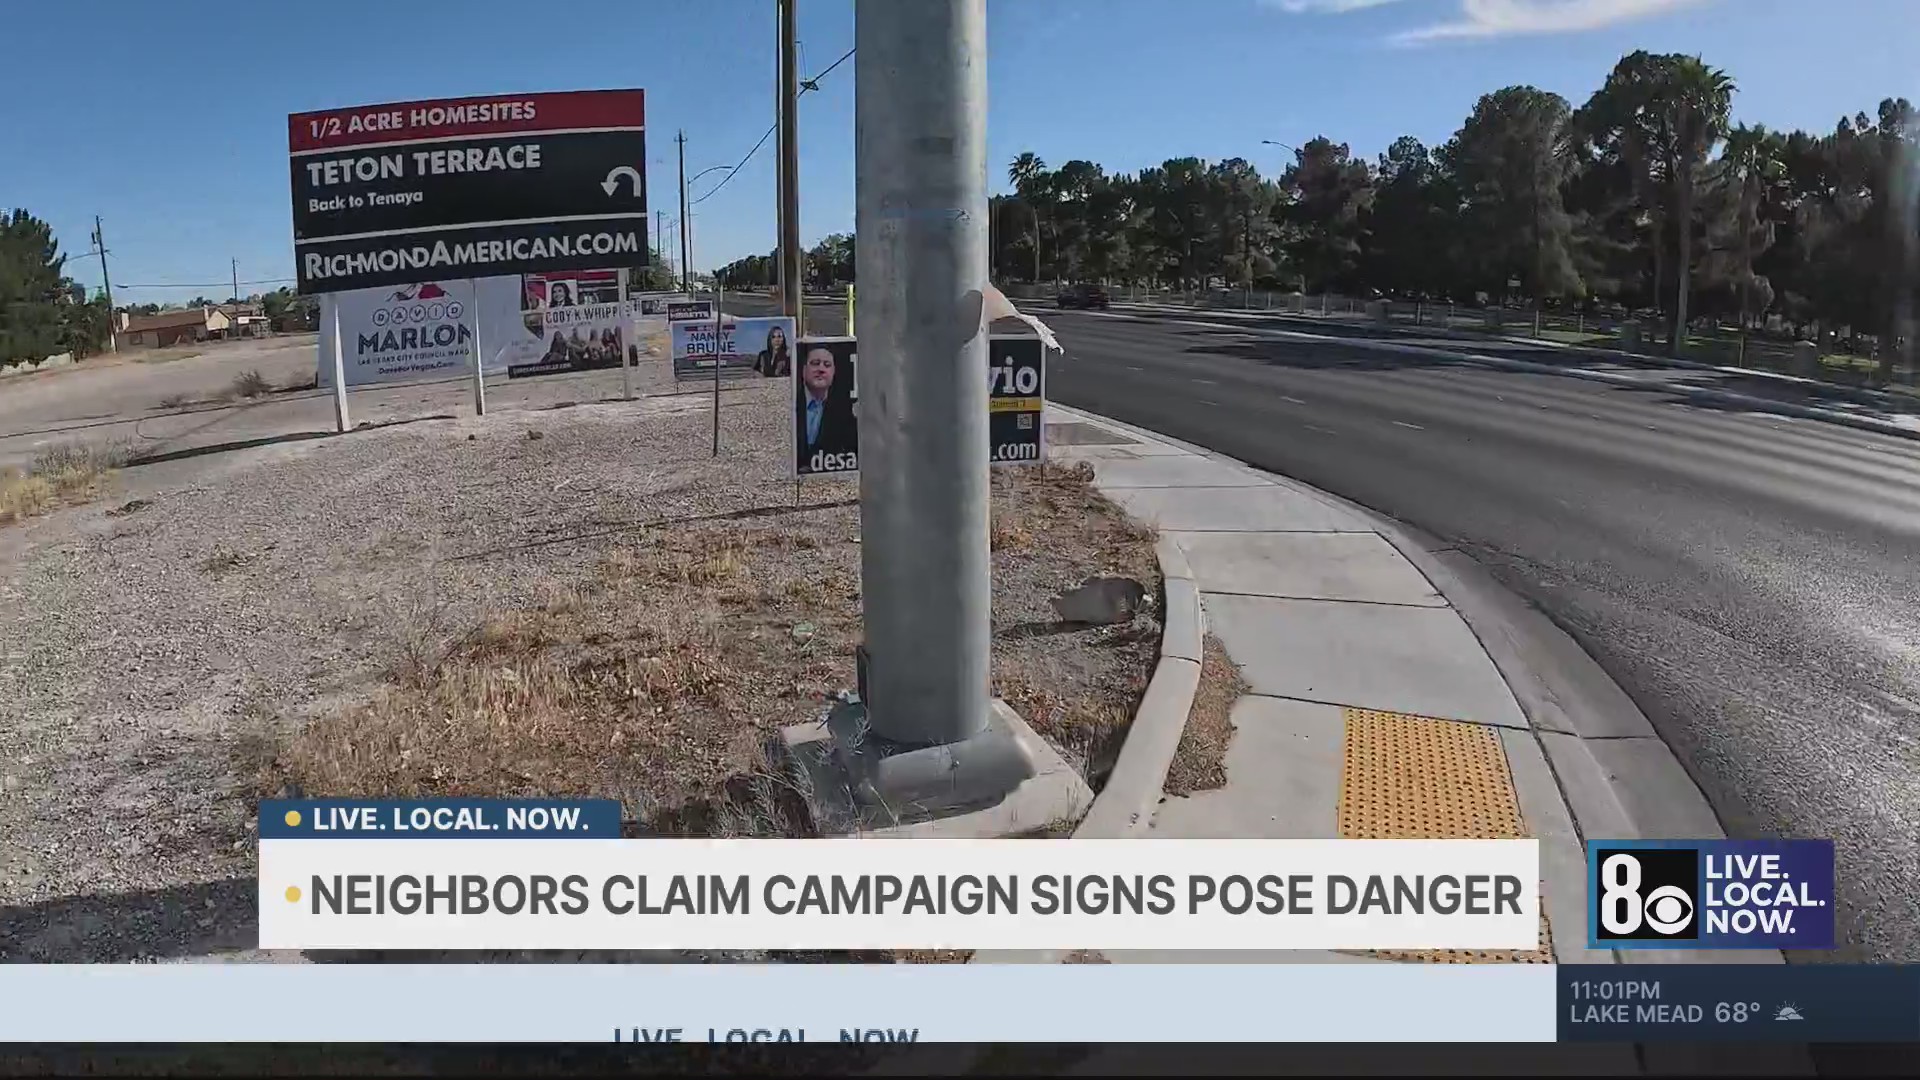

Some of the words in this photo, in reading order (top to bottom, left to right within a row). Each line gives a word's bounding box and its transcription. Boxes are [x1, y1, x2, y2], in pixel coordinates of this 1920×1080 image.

[309, 117, 341, 139] 1/2
[349, 111, 403, 134] ACRE
[410, 101, 536, 127] HOMESITES
[306, 153, 403, 187] TETON
[413, 144, 542, 176] TERRACE
[309, 197, 345, 213] Back
[349, 195, 363, 208] to
[367, 190, 424, 207] Tenaya
[373, 302, 464, 326] DAVID
[546, 310, 571, 324] CODY
[358, 321, 471, 354] MARLON
[687, 342, 735, 354] BRUNE
